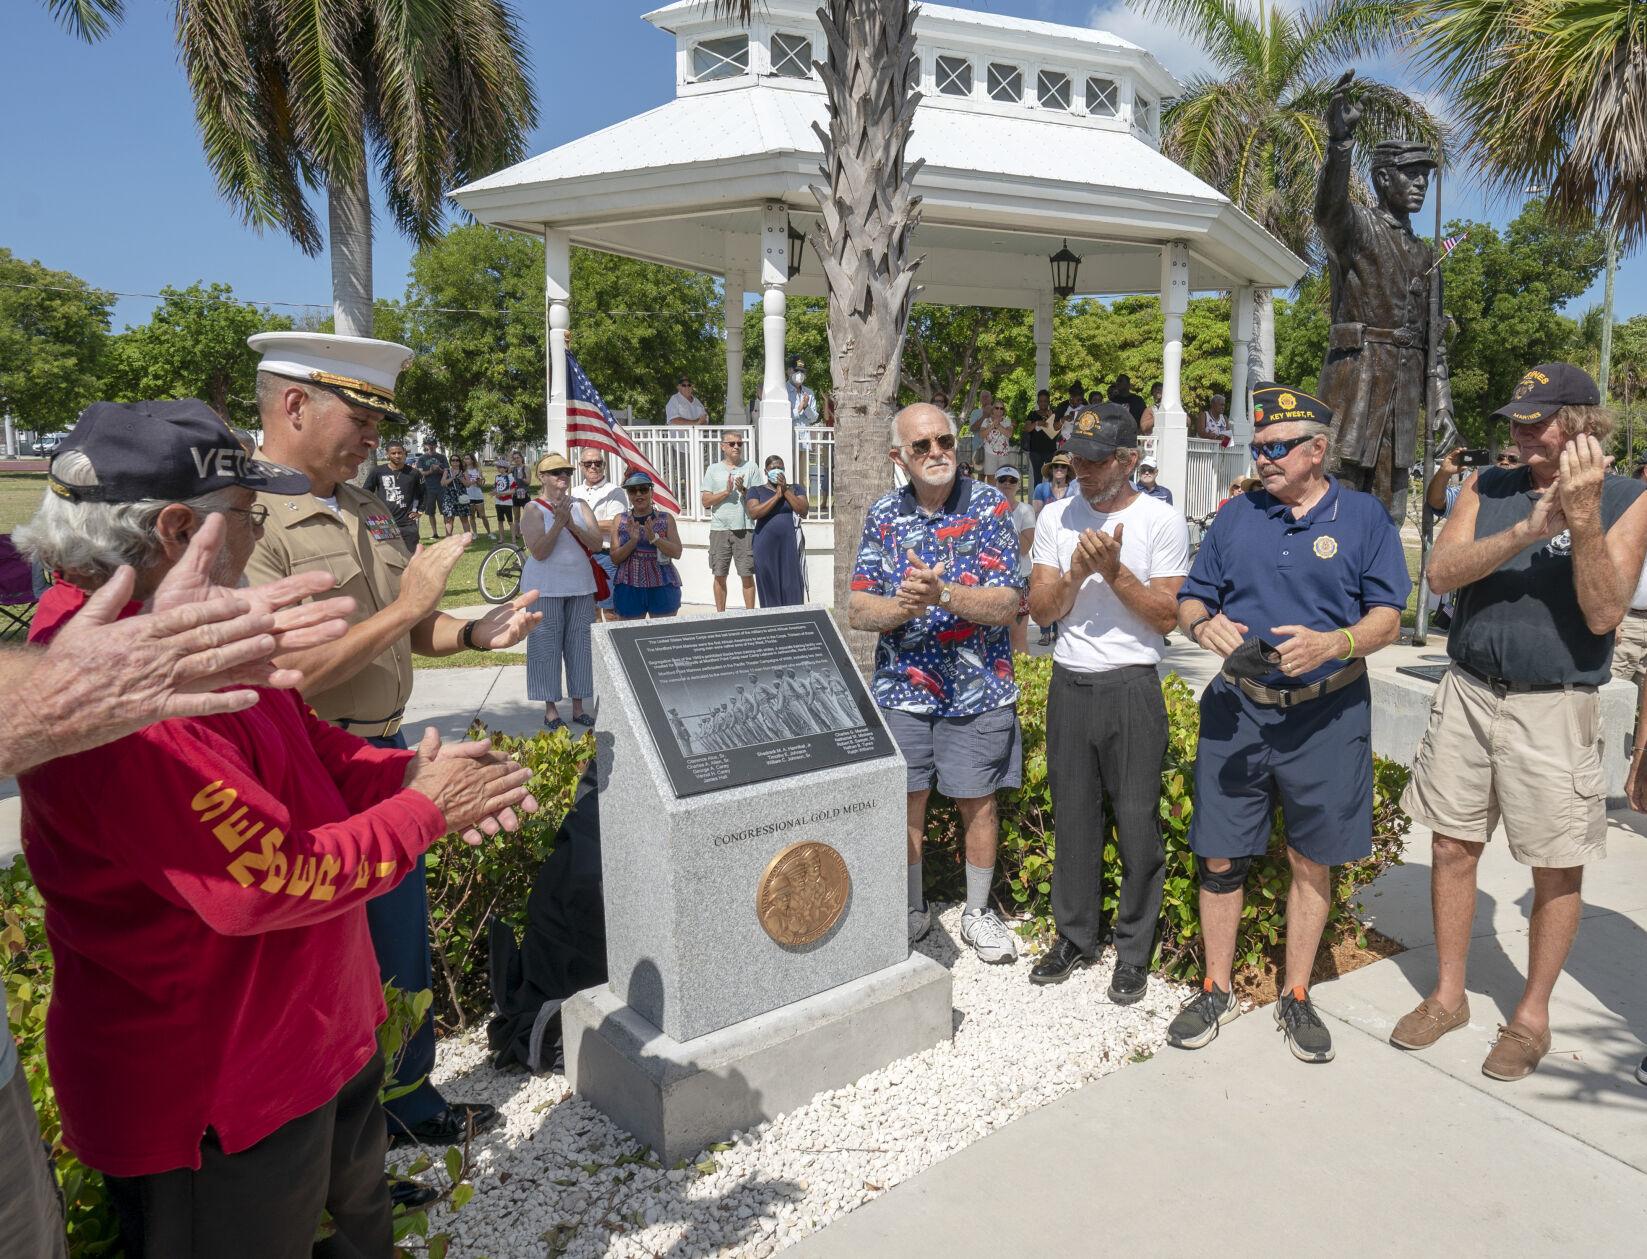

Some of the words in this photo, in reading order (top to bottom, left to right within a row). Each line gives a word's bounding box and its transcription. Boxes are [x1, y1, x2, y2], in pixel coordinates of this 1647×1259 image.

[1270, 412, 1284, 421] KEY
[713, 817, 808, 847] CONGRESSIONAL
[811, 808, 840, 822] GOLD
[843, 799, 878, 814] MEDAL
